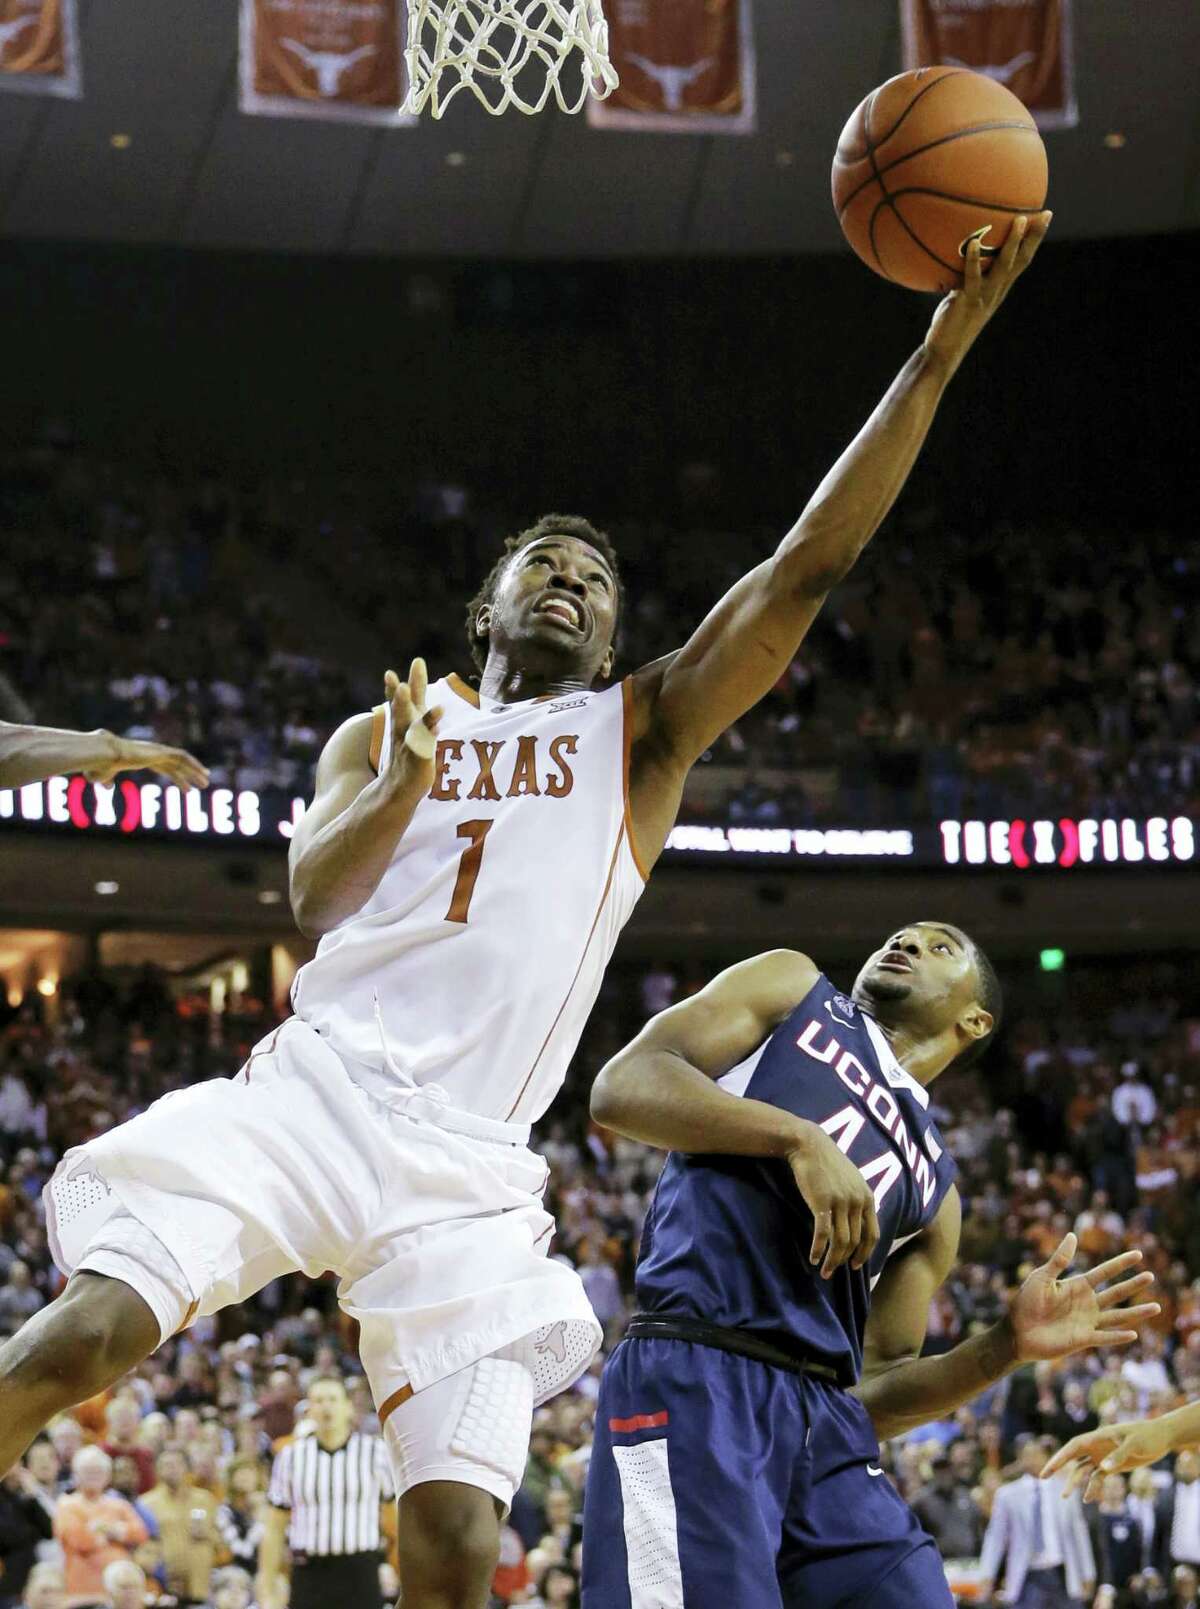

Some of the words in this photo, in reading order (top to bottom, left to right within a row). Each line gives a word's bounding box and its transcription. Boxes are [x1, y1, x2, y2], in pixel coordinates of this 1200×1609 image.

[428, 734, 580, 801] EXAS
[444, 819, 494, 923] 1
[796, 1019, 937, 1209] UCONN
